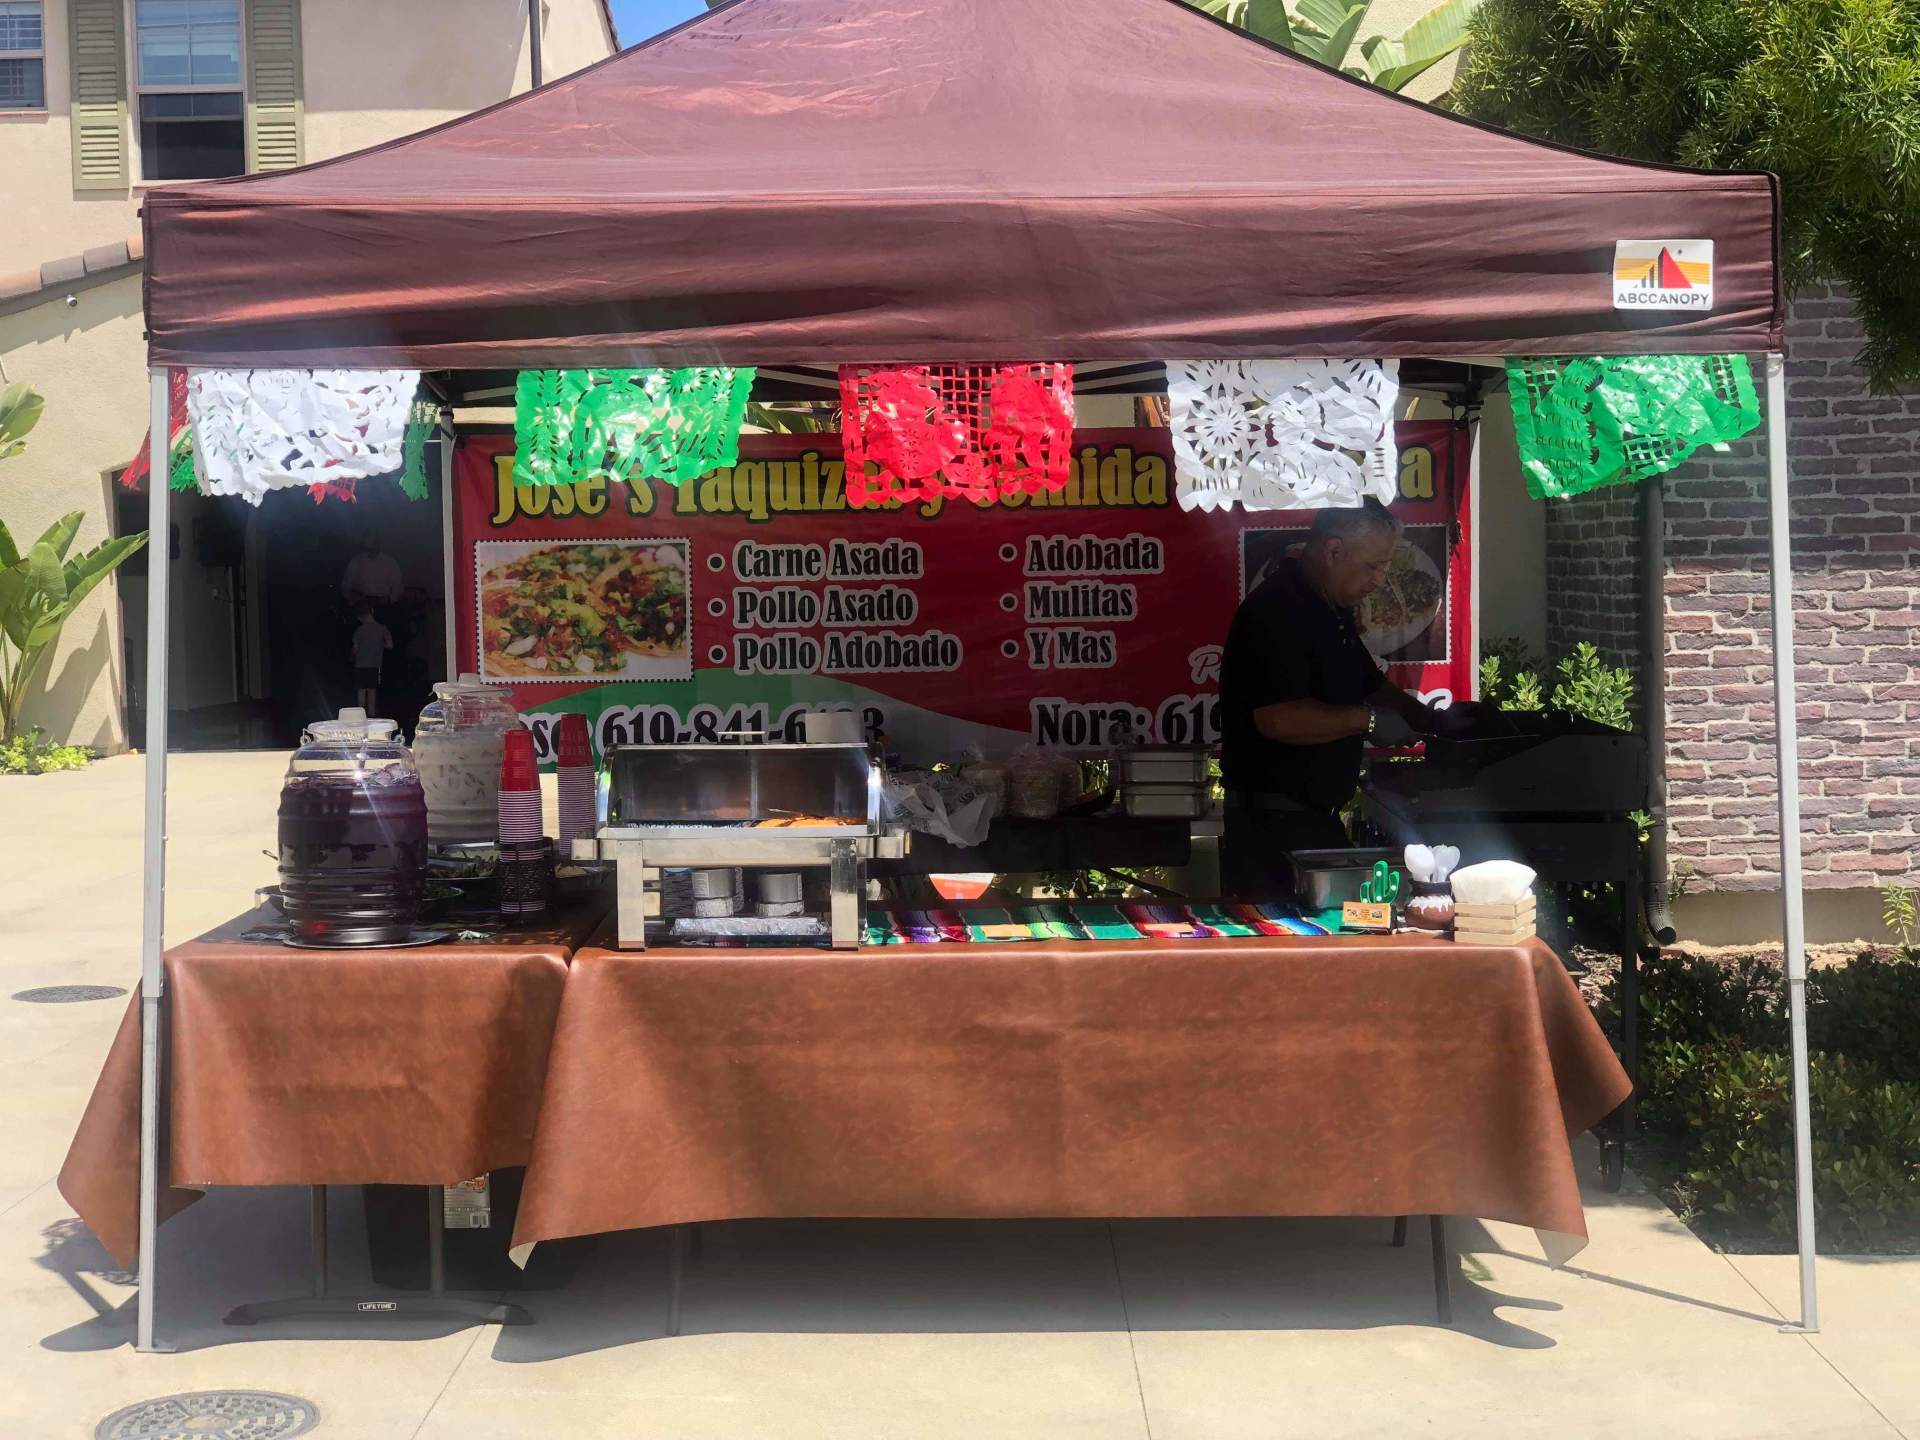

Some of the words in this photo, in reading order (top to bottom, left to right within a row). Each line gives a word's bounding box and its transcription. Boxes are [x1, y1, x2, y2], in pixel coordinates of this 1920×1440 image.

[1617, 292, 1710, 305] ABCCANOPY
[973, 447, 1168, 509] mida
[735, 543, 824, 580] Carne
[829, 540, 922, 577] Asada
[1025, 536, 1162, 573] Adobada
[735, 589, 818, 626] Pollo
[823, 587, 915, 623] Asado
[1027, 583, 1135, 619] Mulitas
[736, 635, 818, 672] Pollo
[824, 632, 960, 670] Adobado
[1028, 630, 1050, 666] Y
[1056, 629, 1114, 665] Mas
[602, 707, 885, 744] 619-841-63
[1034, 702, 1147, 747] Nora:
